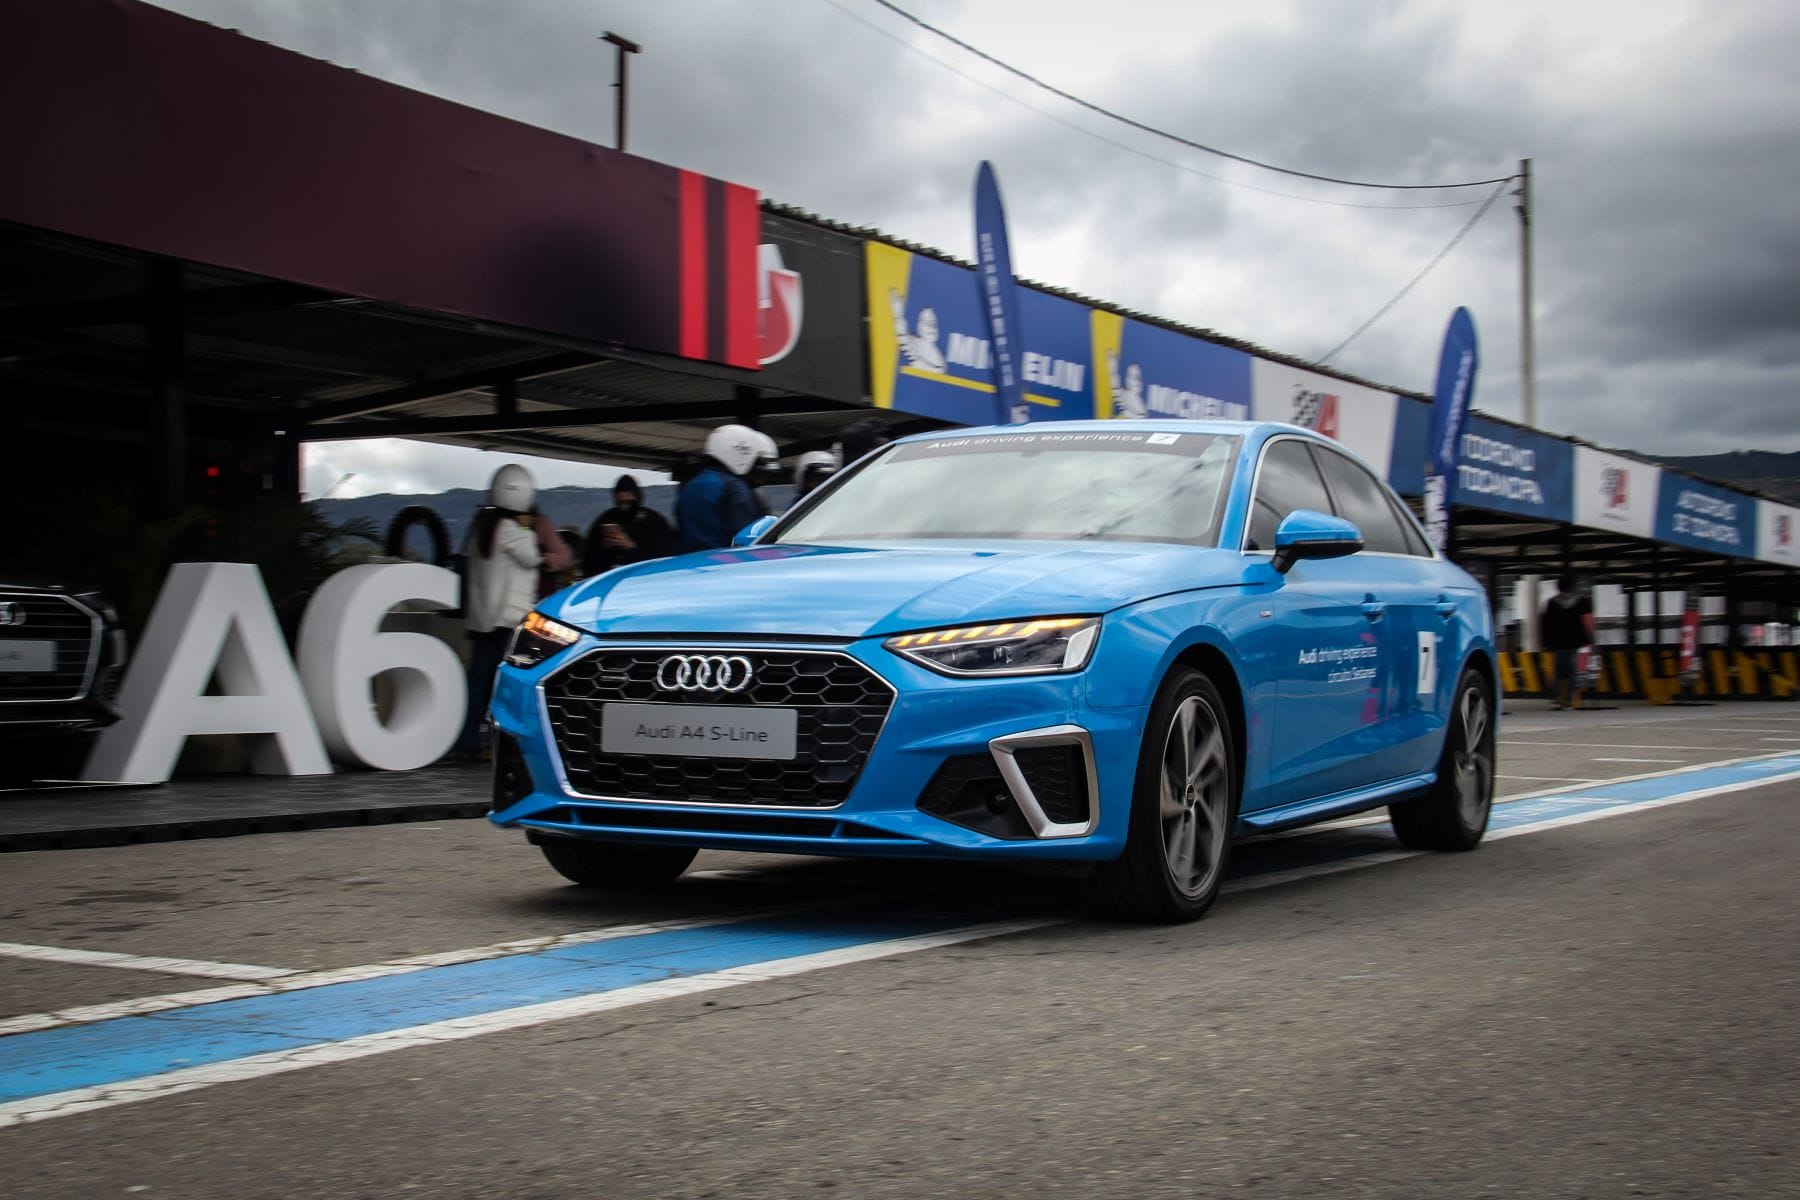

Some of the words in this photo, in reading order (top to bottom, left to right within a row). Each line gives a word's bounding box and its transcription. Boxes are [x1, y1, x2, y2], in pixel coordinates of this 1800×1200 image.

[946, 332, 1085, 392] MIELIN
[1147, 384, 1248, 420] MICHELIN
[926, 440, 970, 449] Audi
[974, 434, 1036, 445] driving
[1041, 433, 1143, 443] experience
[1298, 648, 1318, 664] Audi
[634, 723, 676, 739] Audi
[678, 725, 705, 740] A4
[709, 726, 769, 743] S-Line
